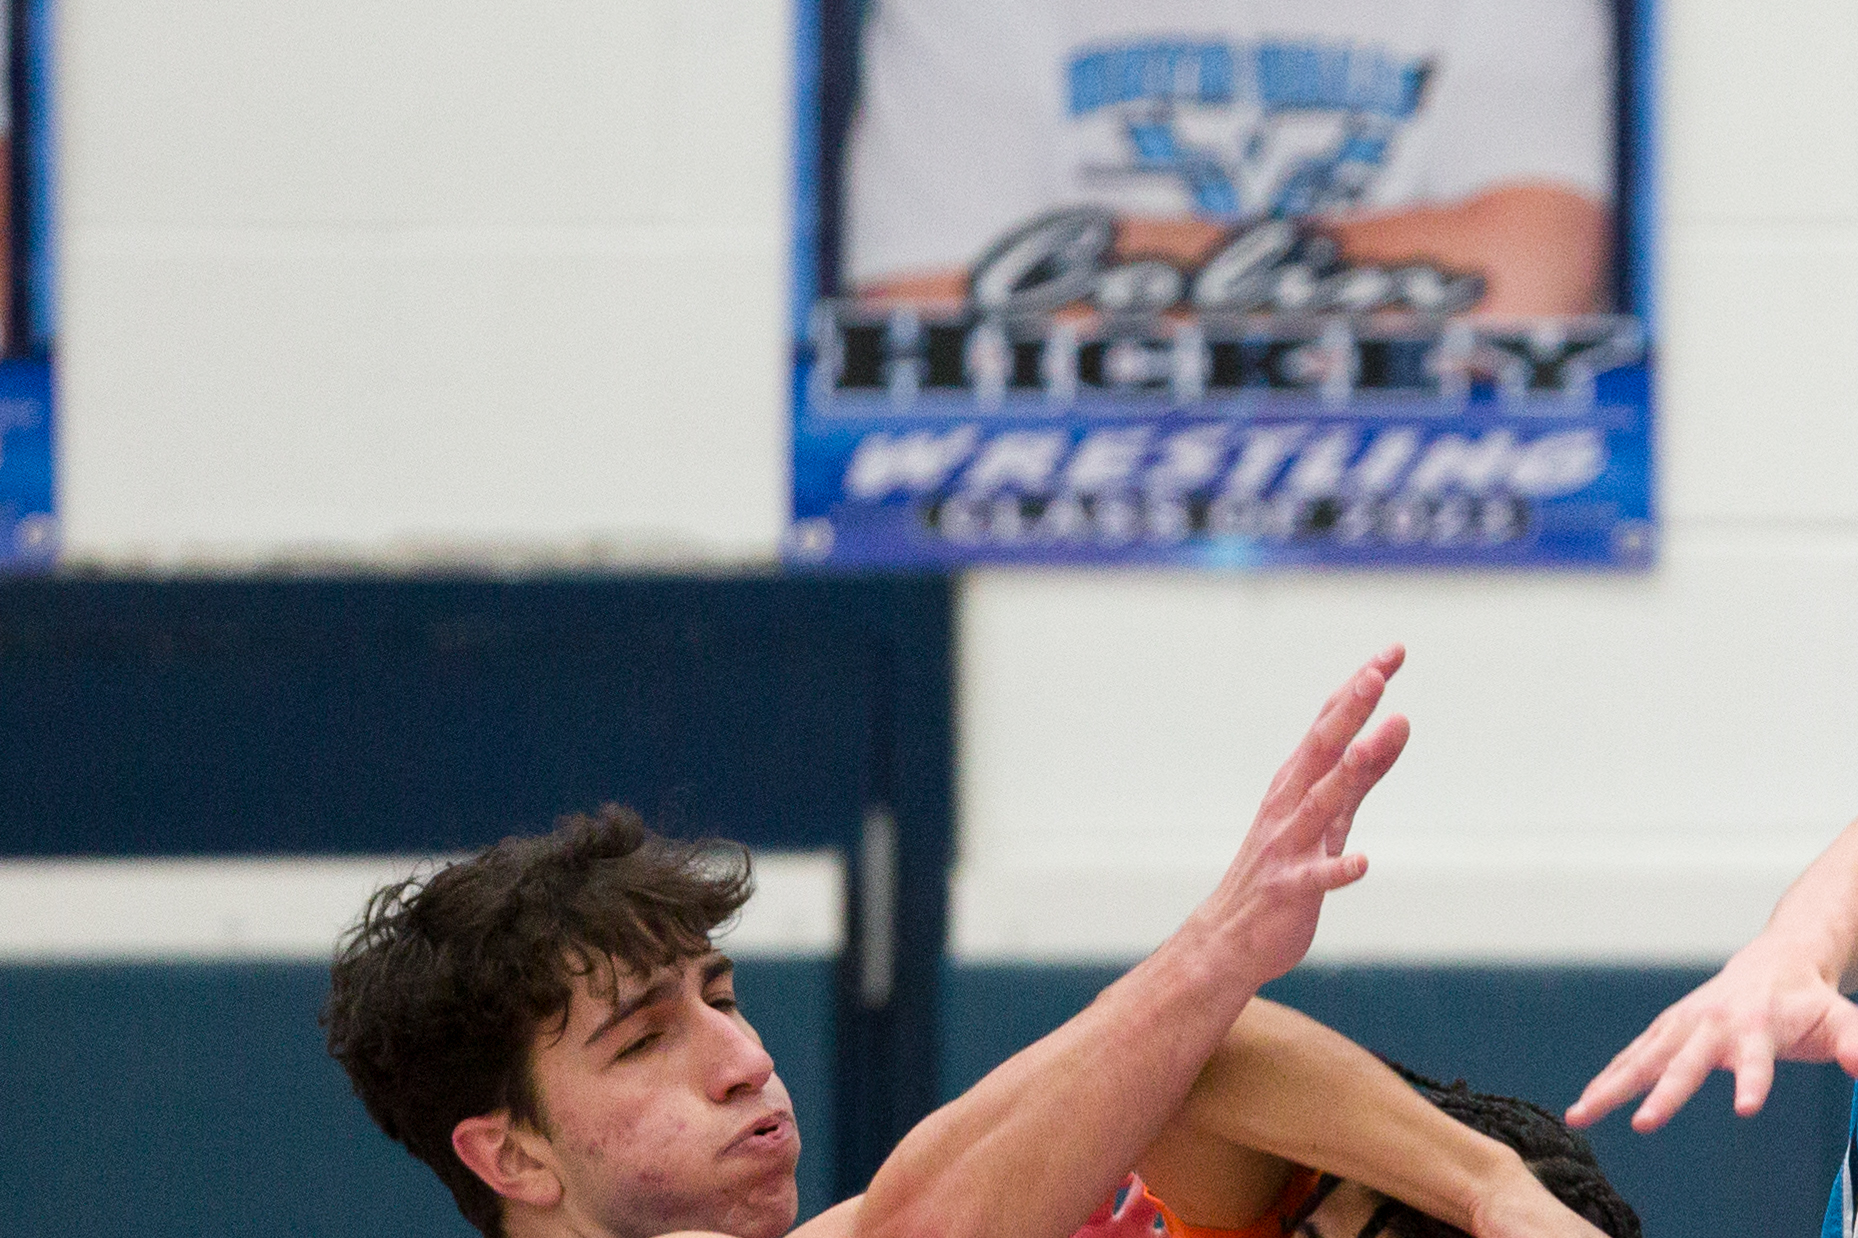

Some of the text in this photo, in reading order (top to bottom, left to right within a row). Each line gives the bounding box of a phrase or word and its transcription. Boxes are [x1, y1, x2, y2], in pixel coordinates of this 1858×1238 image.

[966, 203, 1488, 322] Colin
[818, 307, 1636, 408] HICKEY
[846, 428, 1608, 496] WRESTLING
